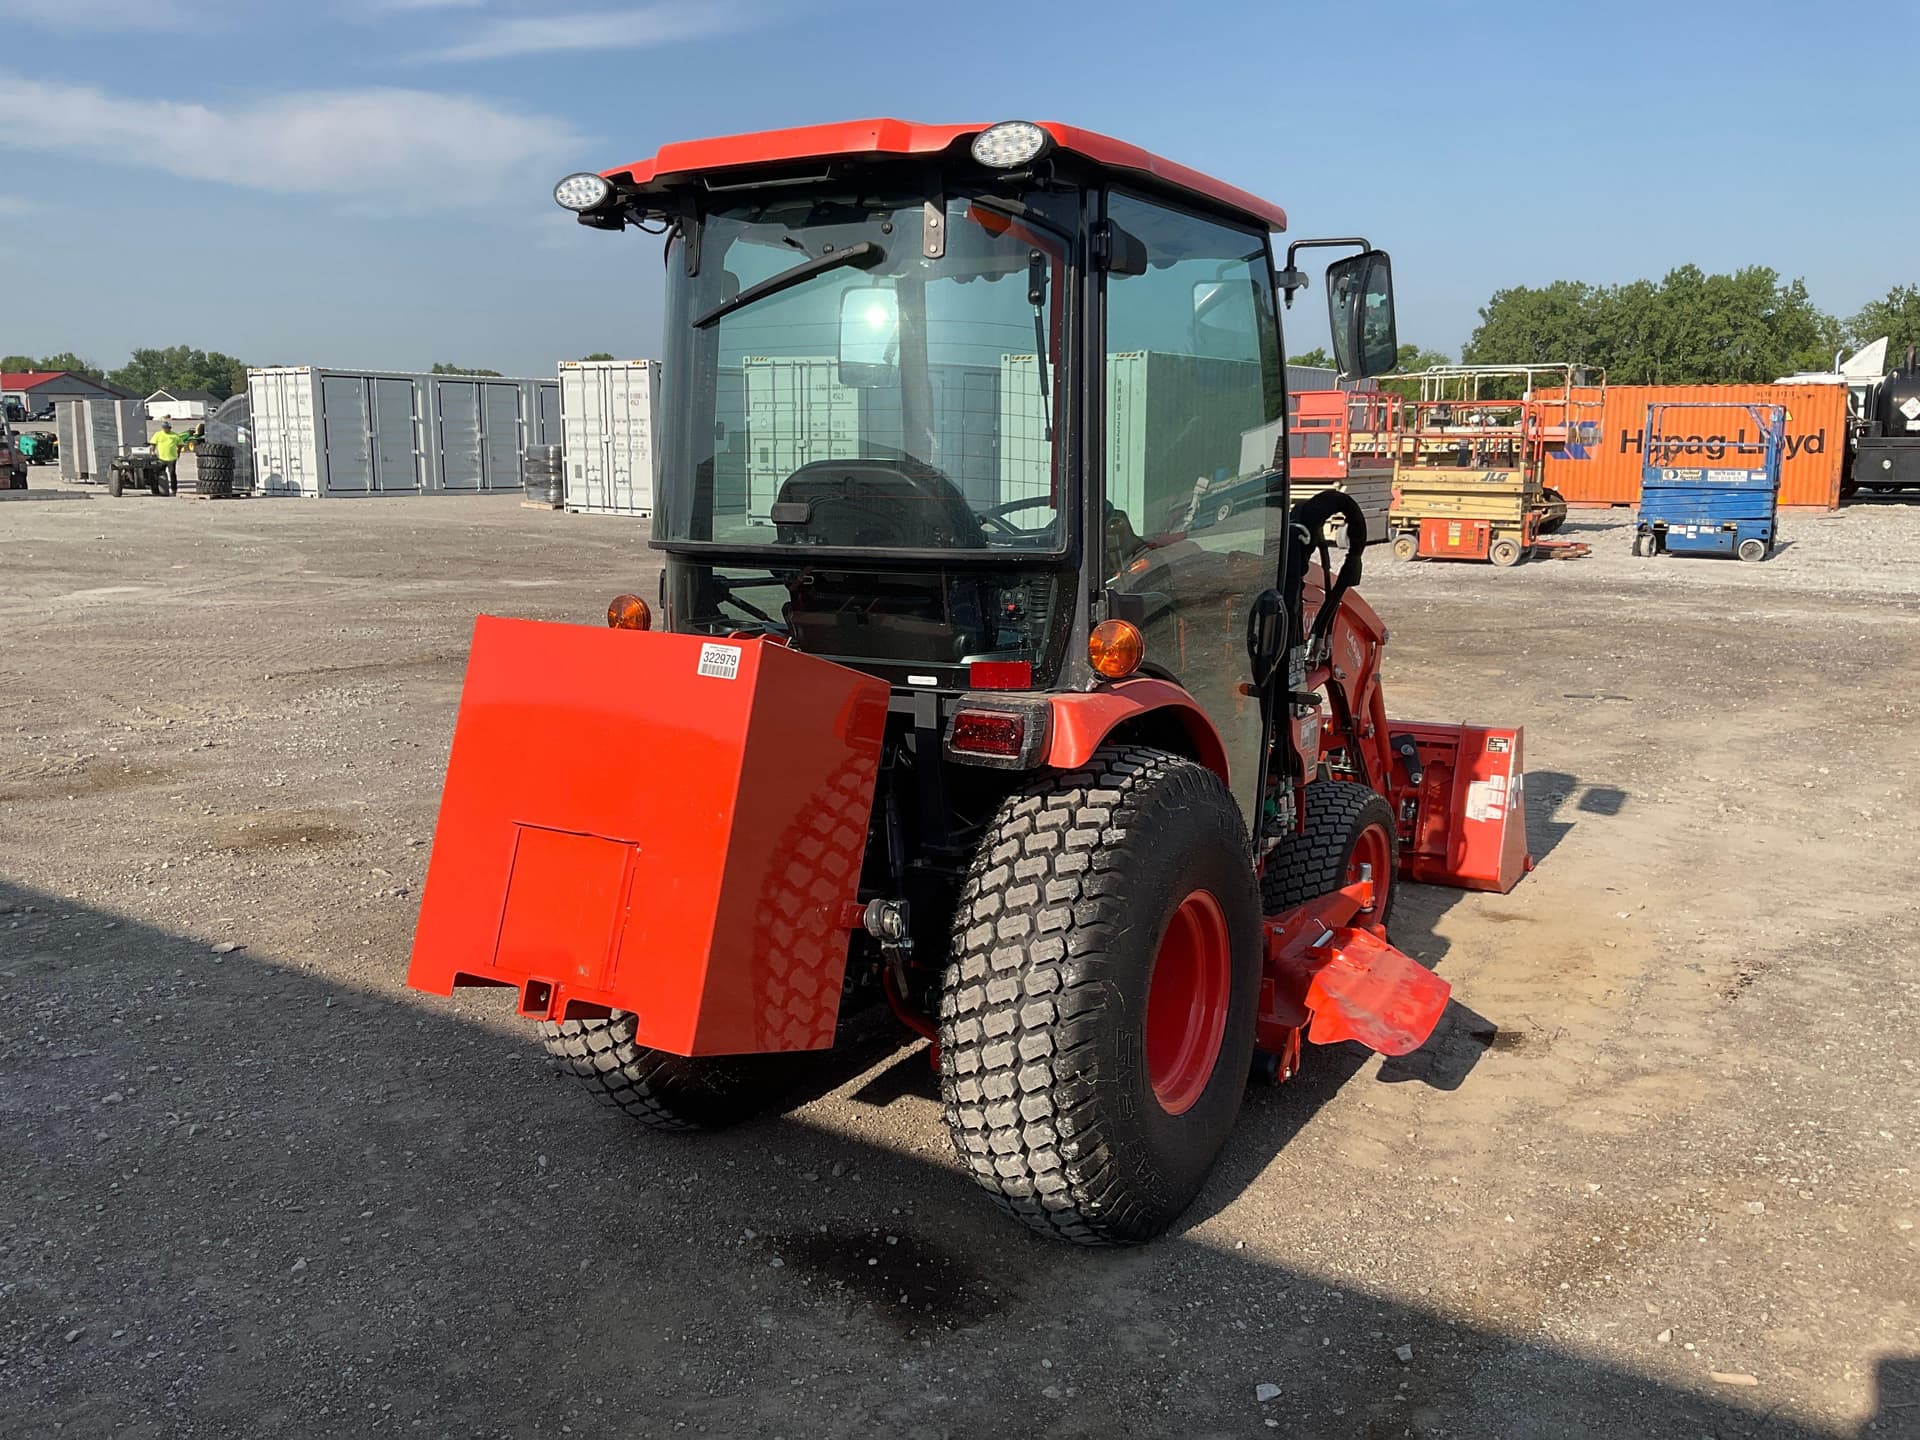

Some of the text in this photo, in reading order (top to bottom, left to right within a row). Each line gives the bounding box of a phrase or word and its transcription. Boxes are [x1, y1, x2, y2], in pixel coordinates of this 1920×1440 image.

[1620, 429, 1825, 460] Hapag-Llyd
[1481, 471, 1508, 482] JLG
[703, 652, 737, 666] 322979
